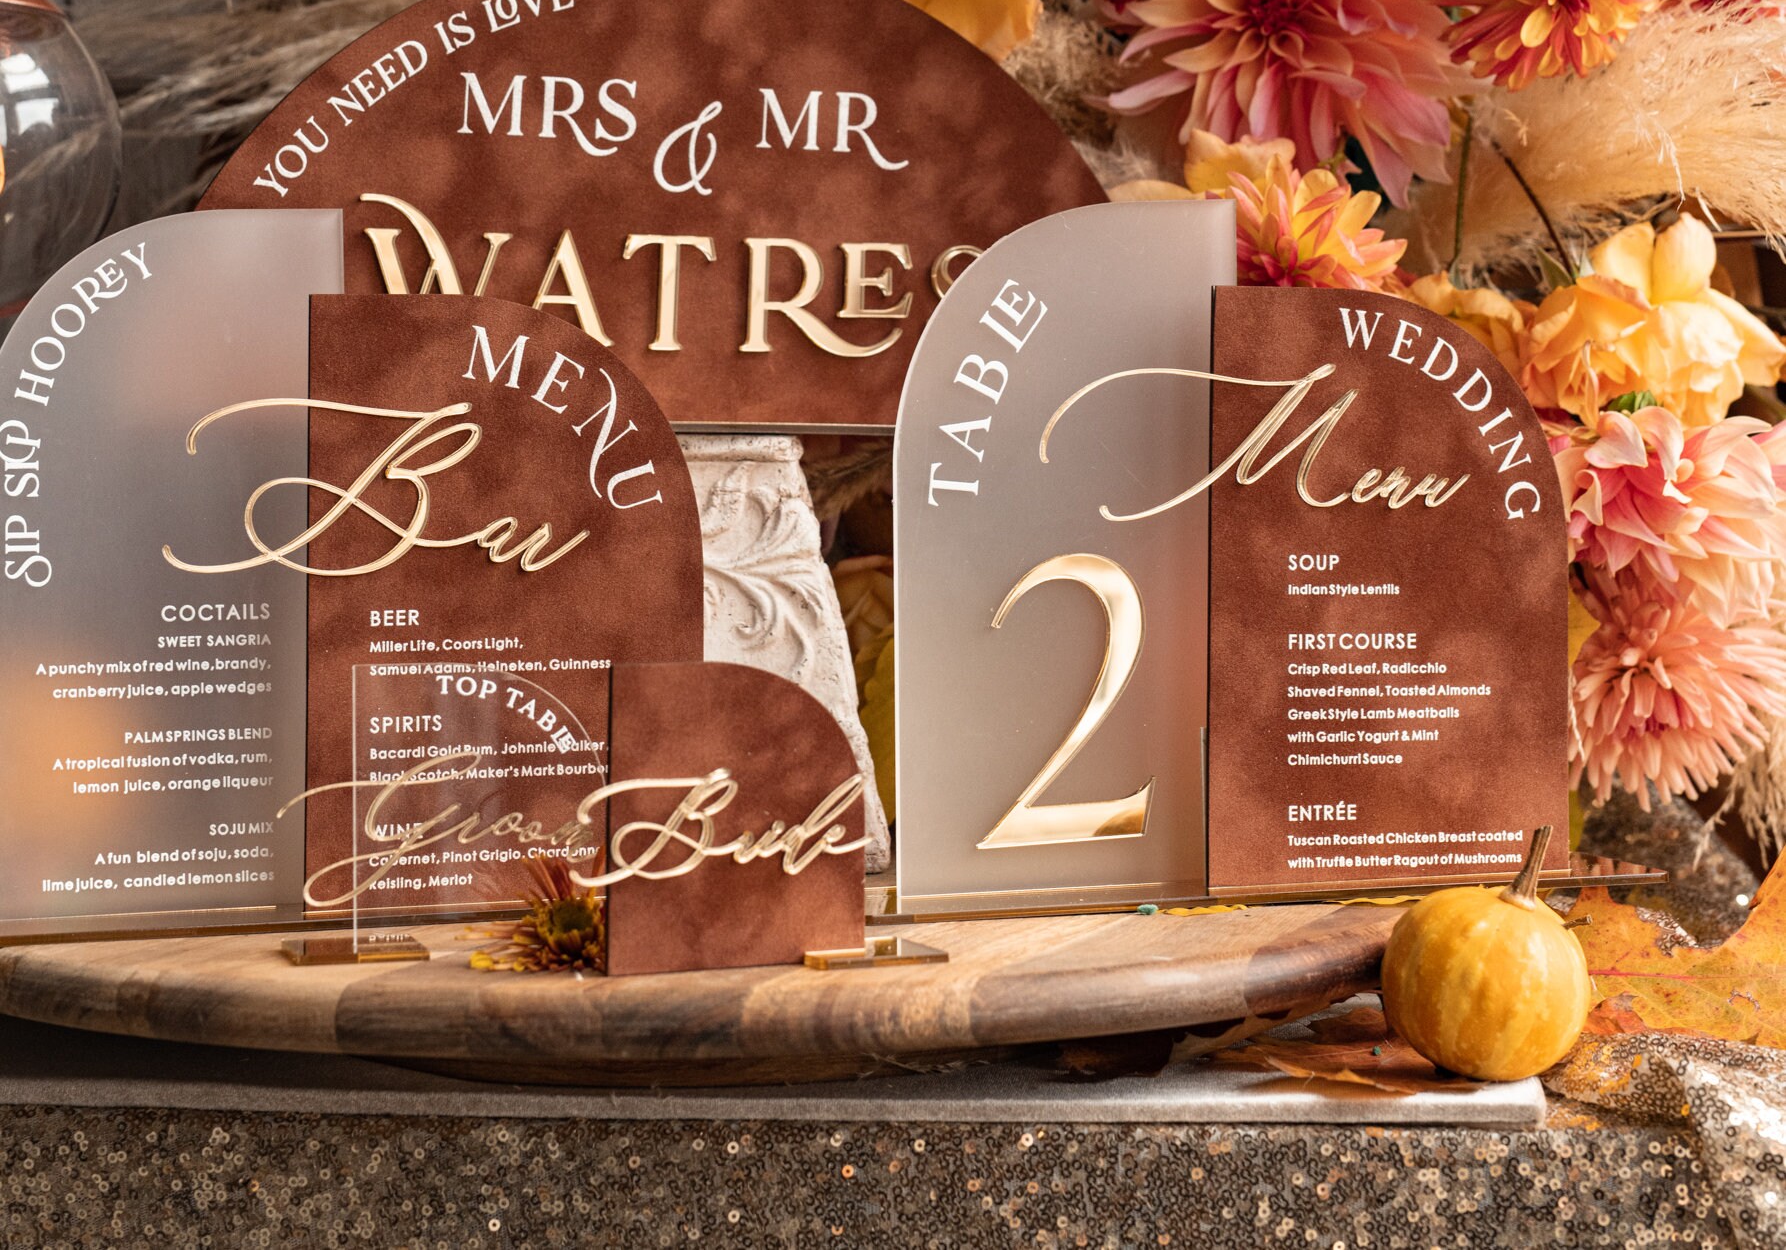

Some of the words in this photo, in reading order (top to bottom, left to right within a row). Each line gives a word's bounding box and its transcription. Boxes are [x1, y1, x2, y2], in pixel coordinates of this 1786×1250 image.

[252, 115, 330, 198] YOU
[327, 40, 428, 127] NEED
[433, 11, 476, 55] IS
[457, 72, 638, 157] MRS
[653, 101, 722, 196] &
[755, 88, 910, 171] MR
[14, 242, 152, 406] HOOREY
[927, 279, 1049, 507] TABLE
[461, 325, 664, 511] MENU
[1338, 307, 1541, 520] WEDDING
[1038, 363, 1471, 522] Menu
[162, 398, 591, 577] Bar
[4, 514, 52, 588] SIP
[1288, 554, 1340, 571] SOUP
[1288, 584, 1328, 595] Indian
[1329, 583, 1359, 597] Style
[1361, 583, 1400, 595] Lentils
[161, 603, 271, 623] COCTAILS
[369, 609, 420, 627] BEER
[157, 635, 202, 648] SWEET
[206, 634, 271, 647] SANGRIA
[369, 641, 409, 653] Miller
[410, 640, 440, 652] Lite,
[442, 639, 483, 650] Coors
[484, 637, 524, 651] Light,
[1288, 634, 1336, 650] FIRST
[1338, 633, 1417, 650] COURSE
[36, 664, 47, 675] A
[49, 661, 105, 677] punchy
[106, 661, 132, 673] mix
[132, 660, 148, 673] of
[149, 659, 174, 672] red
[176, 659, 215, 672] wine,
[215, 657, 271, 671] brandy,
[369, 665, 421, 676] Samuel
[423, 662, 476, 675] Adams,
[477, 660, 547, 673] Heineken,
[549, 658, 611, 671] Guinness
[1288, 664, 1320, 677] Crisp
[1322, 663, 1347, 674] Red
[1349, 663, 1381, 675] Leaf,
[1382, 662, 1447, 674] Radicchio
[53, 684, 126, 700] cranberry
[127, 684, 168, 699] juice,
[171, 682, 214, 697] apple
[216, 681, 272, 695] wedges
[1287, 686, 1336, 698] Shaved
[1337, 686, 1384, 698] Fennel,
[1385, 685, 1435, 696] Toasted
[1437, 684, 1491, 696] Almonds
[976, 552, 1157, 850] 2
[435, 674, 497, 699] TOP
[505, 687, 577, 754] TABLE
[1287, 709, 1327, 721] Greek
[1327, 708, 1359, 722] Style
[1361, 707, 1395, 719] Lamb
[1396, 706, 1460, 719] Meatballs
[369, 715, 442, 734] SPIRITS
[124, 731, 164, 744] PALM
[166, 728, 226, 743] SPRINGS
[228, 727, 273, 741] BLEND
[1287, 731, 1315, 743] with
[1316, 731, 1355, 743] Garlic
[1357, 730, 1399, 744] Yogurt
[1401, 730, 1411, 742] &
[1412, 729, 1439, 741] Mint
[369, 746, 425, 760] Bacardi
[427, 744, 462, 758] Gold
[501, 741, 556, 754] Johnnie
[1287, 753, 1361, 766] Chimichurri
[1363, 753, 1403, 765] Sauce
[53, 759, 64, 771] A
[66, 755, 124, 772] tropical
[127, 754, 170, 767] fusion
[172, 753, 188, 766] of
[189, 752, 239, 766] vodka,
[241, 752, 273, 764] rum,
[369, 770, 405, 783] Blac
[520, 765, 555, 777] Mark
[73, 780, 119, 794] lemon
[124, 779, 166, 794] juice,
[168, 778, 221, 792] orange
[223, 775, 274, 789] liqueur
[1288, 801, 1357, 822] ENTRÉE
[209, 823, 246, 836] SOJU
[248, 822, 274, 834] MIX
[1287, 835, 1332, 846] Tuscan
[1333, 833, 1384, 846] Roasted
[1386, 831, 1437, 844] Chicken
[1438, 831, 1476, 843] Breast
[1477, 830, 1523, 842] coated
[95, 853, 106, 865] A
[107, 852, 131, 865] fun
[136, 850, 179, 863] blend
[181, 849, 197, 862] of
[198, 848, 231, 862] soju,
[233, 846, 274, 859] soda,
[442, 850, 477, 863] Pinot
[1287, 857, 1315, 869] with
[1316, 856, 1354, 868] Truffle
[1355, 855, 1392, 867] Butter
[1394, 854, 1439, 868] Ragout
[1440, 853, 1453, 865] of
[1454, 852, 1522, 865] Mushrooms
[43, 879, 74, 892] lime
[75, 877, 118, 892] juice,
[123, 873, 185, 888] candied
[187, 872, 233, 885] lemon
[235, 869, 274, 883] slices
[428, 873, 473, 887] Merlot
